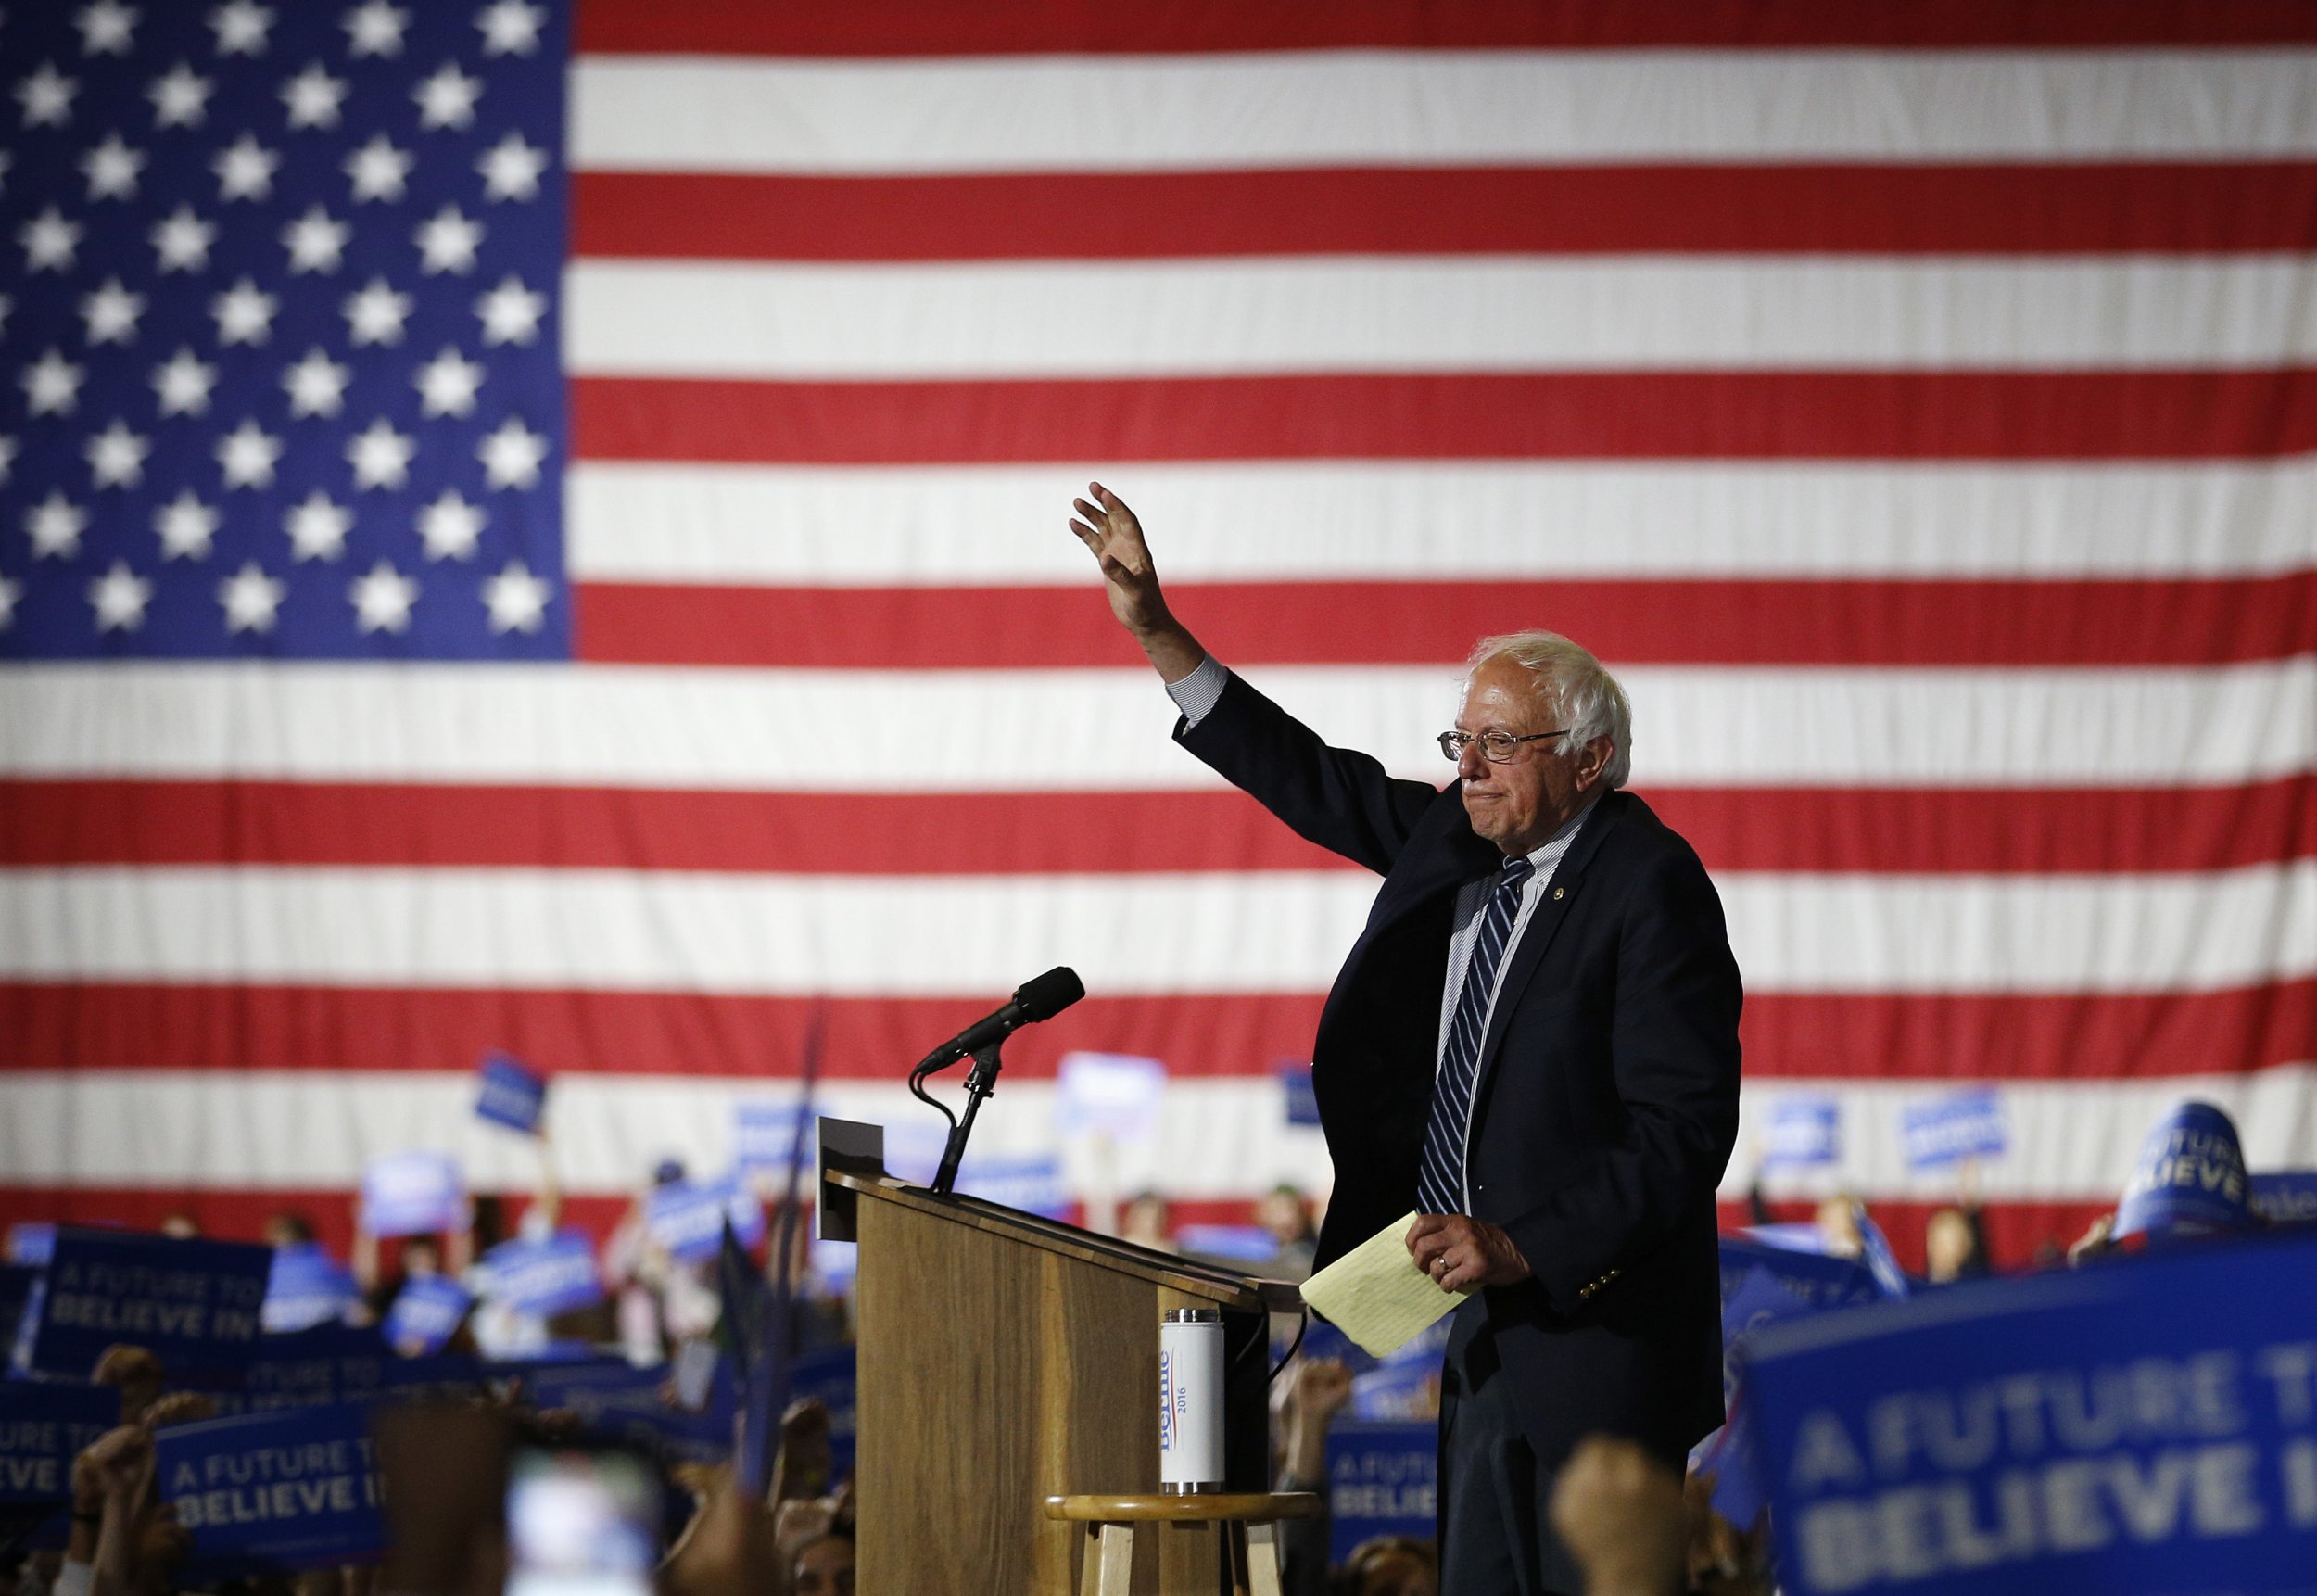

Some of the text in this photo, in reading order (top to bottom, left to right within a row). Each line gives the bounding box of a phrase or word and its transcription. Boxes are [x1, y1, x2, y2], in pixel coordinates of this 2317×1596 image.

[58, 1261, 265, 1301] A FUTURE TO
[49, 1292, 258, 1343] BELIEVE IN
[1177, 1387, 1187, 1415] 2016
[1786, 1405, 1870, 1494] A
[1863, 1348, 2247, 1483] FUTURE
[172, 1459, 199, 1492] A
[204, 1438, 352, 1488] FUTURE
[1332, 1451, 1359, 1482] A
[173, 1473, 358, 1530] BELIEVE
[1794, 1438, 2269, 1594] BELIEVE
